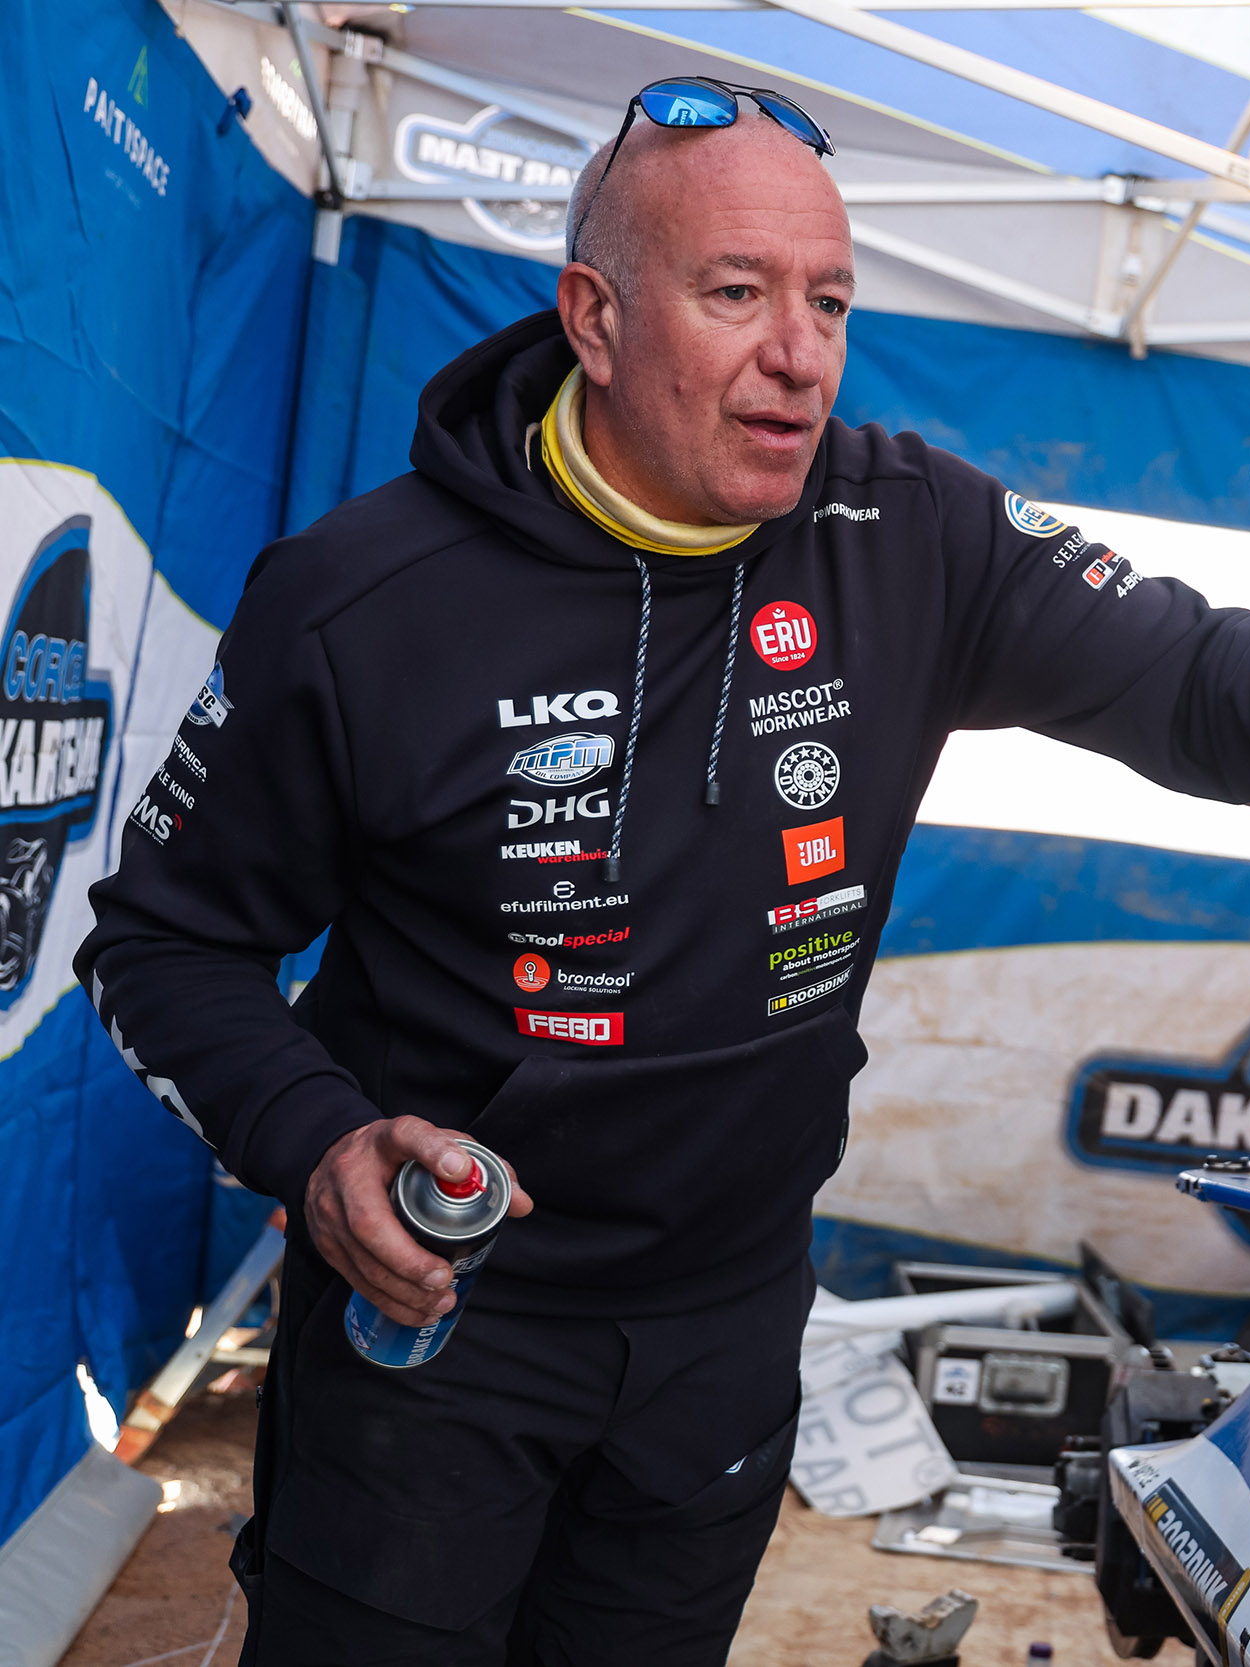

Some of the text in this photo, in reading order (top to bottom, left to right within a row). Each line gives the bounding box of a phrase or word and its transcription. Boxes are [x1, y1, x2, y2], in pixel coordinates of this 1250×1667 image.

[756, 618, 812, 655] ERU
[772, 652, 806, 664] Since 1824
[498, 690, 622, 728] LKQ
[751, 700, 852, 737] WORKWEAR
[550, 769, 585, 780] COMPANY
[780, 766, 837, 805] OPTIMAL
[168, 780, 196, 810] KING
[508, 788, 611, 829] DHG
[501, 840, 581, 860] KEUKEN
[798, 836, 838, 867] JBL
[500, 894, 630, 913] efulfilment.eu
[774, 887, 862, 925] BS FORKLIFTS
[775, 902, 863, 933] INTERNATIONAL
[525, 926, 631, 949] Toolspecial
[769, 930, 854, 970] positive
[783, 937, 860, 972] about motorsport
[557, 968, 631, 987] brondool
[563, 985, 621, 995] LOCKING SOLUTIONS
[788, 969, 852, 1006] ROORDINK
[528, 1013, 611, 1041] FEBO
[405, 1336, 432, 1367] BRAKE
